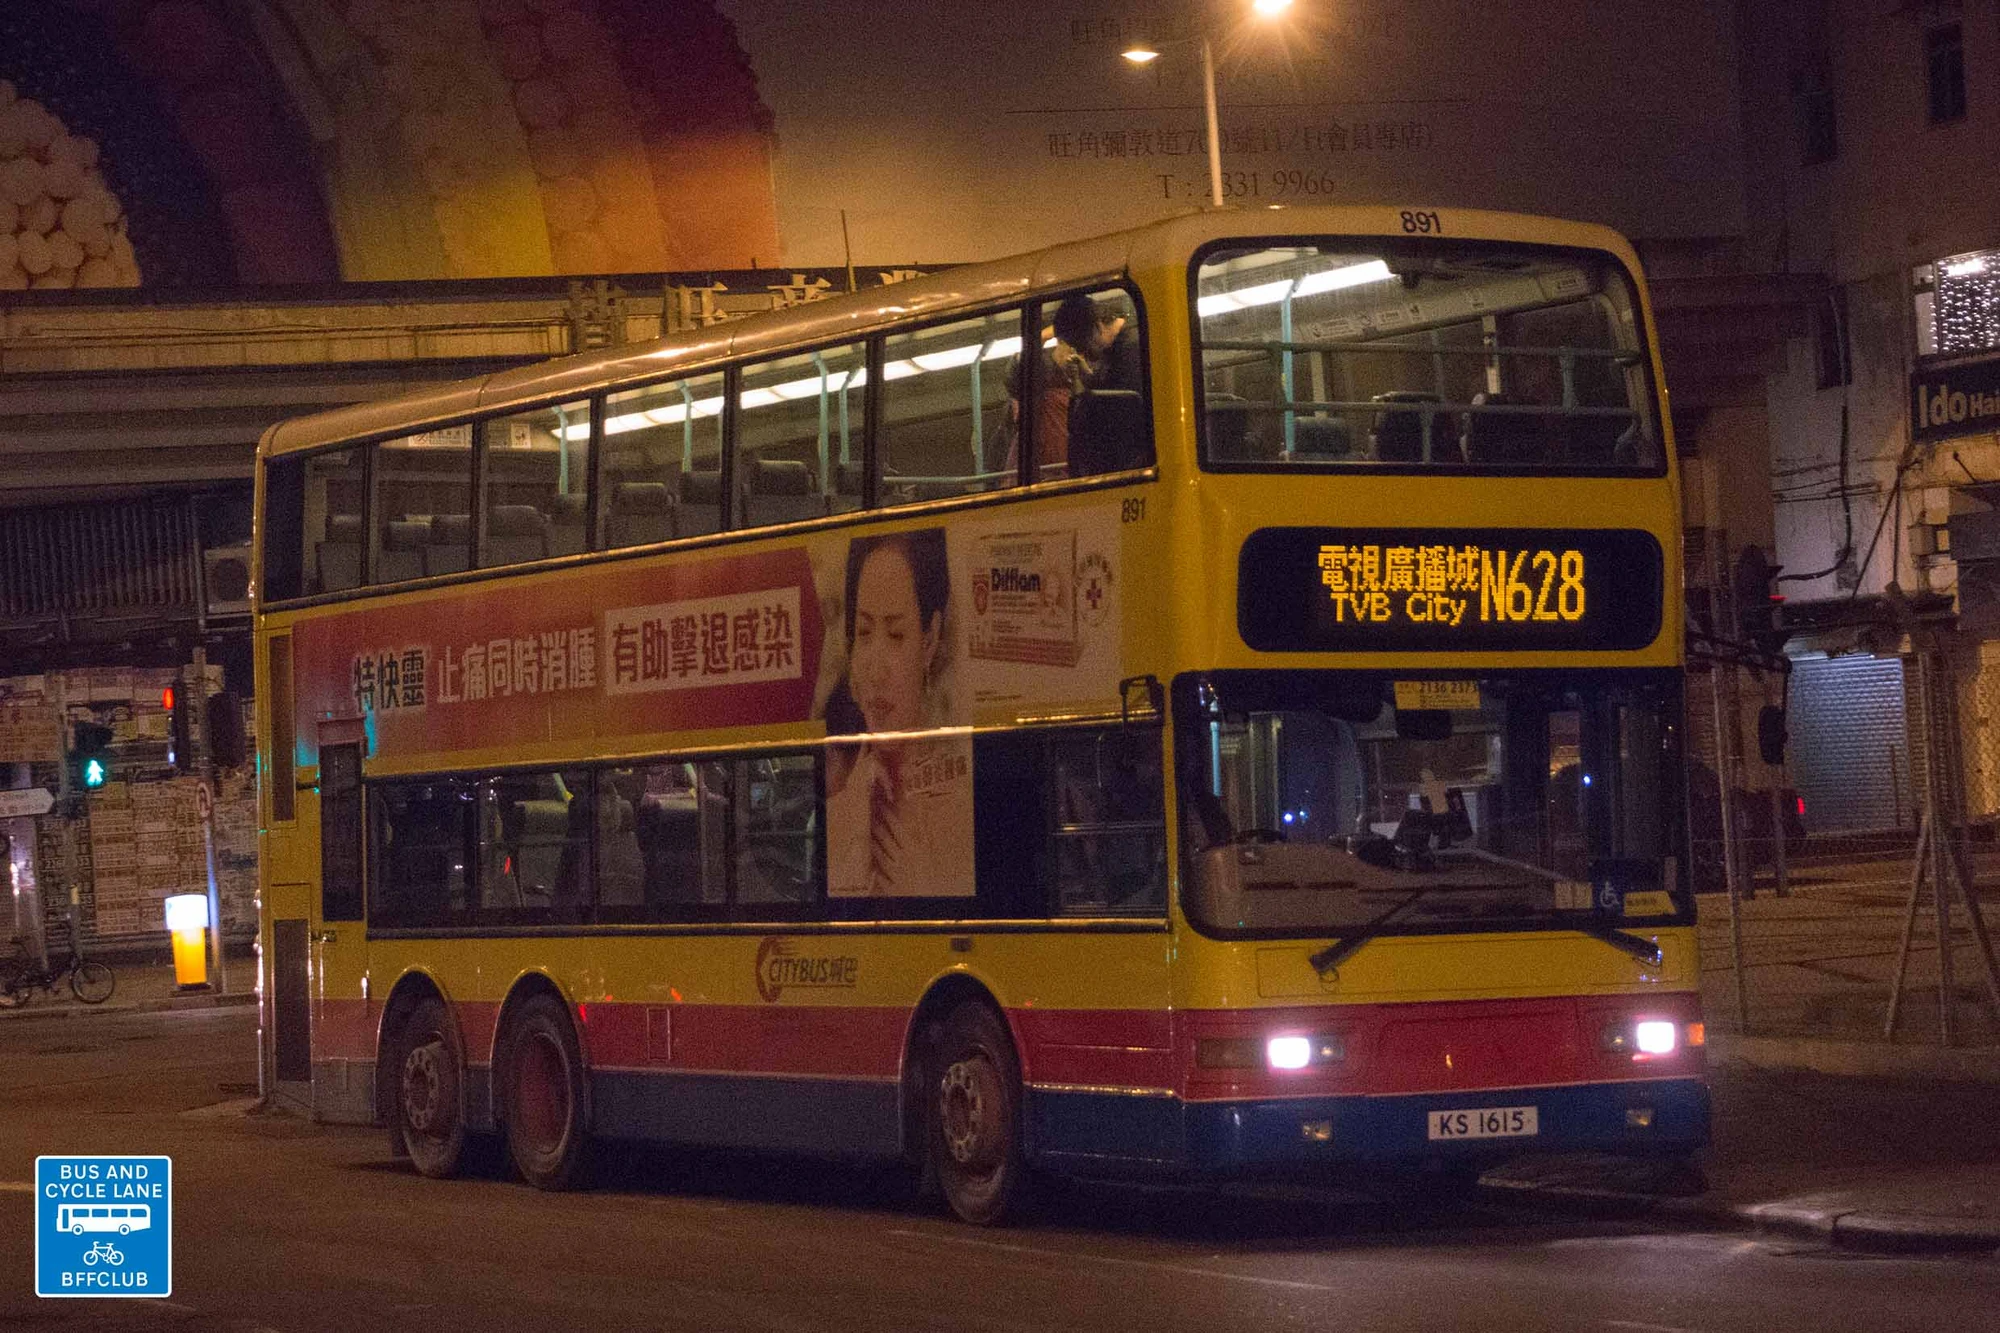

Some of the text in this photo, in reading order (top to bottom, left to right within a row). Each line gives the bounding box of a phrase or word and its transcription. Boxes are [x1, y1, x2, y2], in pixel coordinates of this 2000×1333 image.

[1273, 169, 1335, 195] 9966
[1400, 210, 1442, 234] 891
[1121, 497, 1147, 524] 891
[990, 567, 1042, 592] Difflam
[1317, 544, 1480, 592] 電視廣播城
[1481, 549, 1586, 622] N628
[1330, 592, 1468, 628] TVB City
[353, 603, 795, 713] 特快靈 止痛同時消腫 有助擊退感染
[768, 957, 829, 983] CITYBUS
[1439, 1110, 1524, 1136] KS 1615
